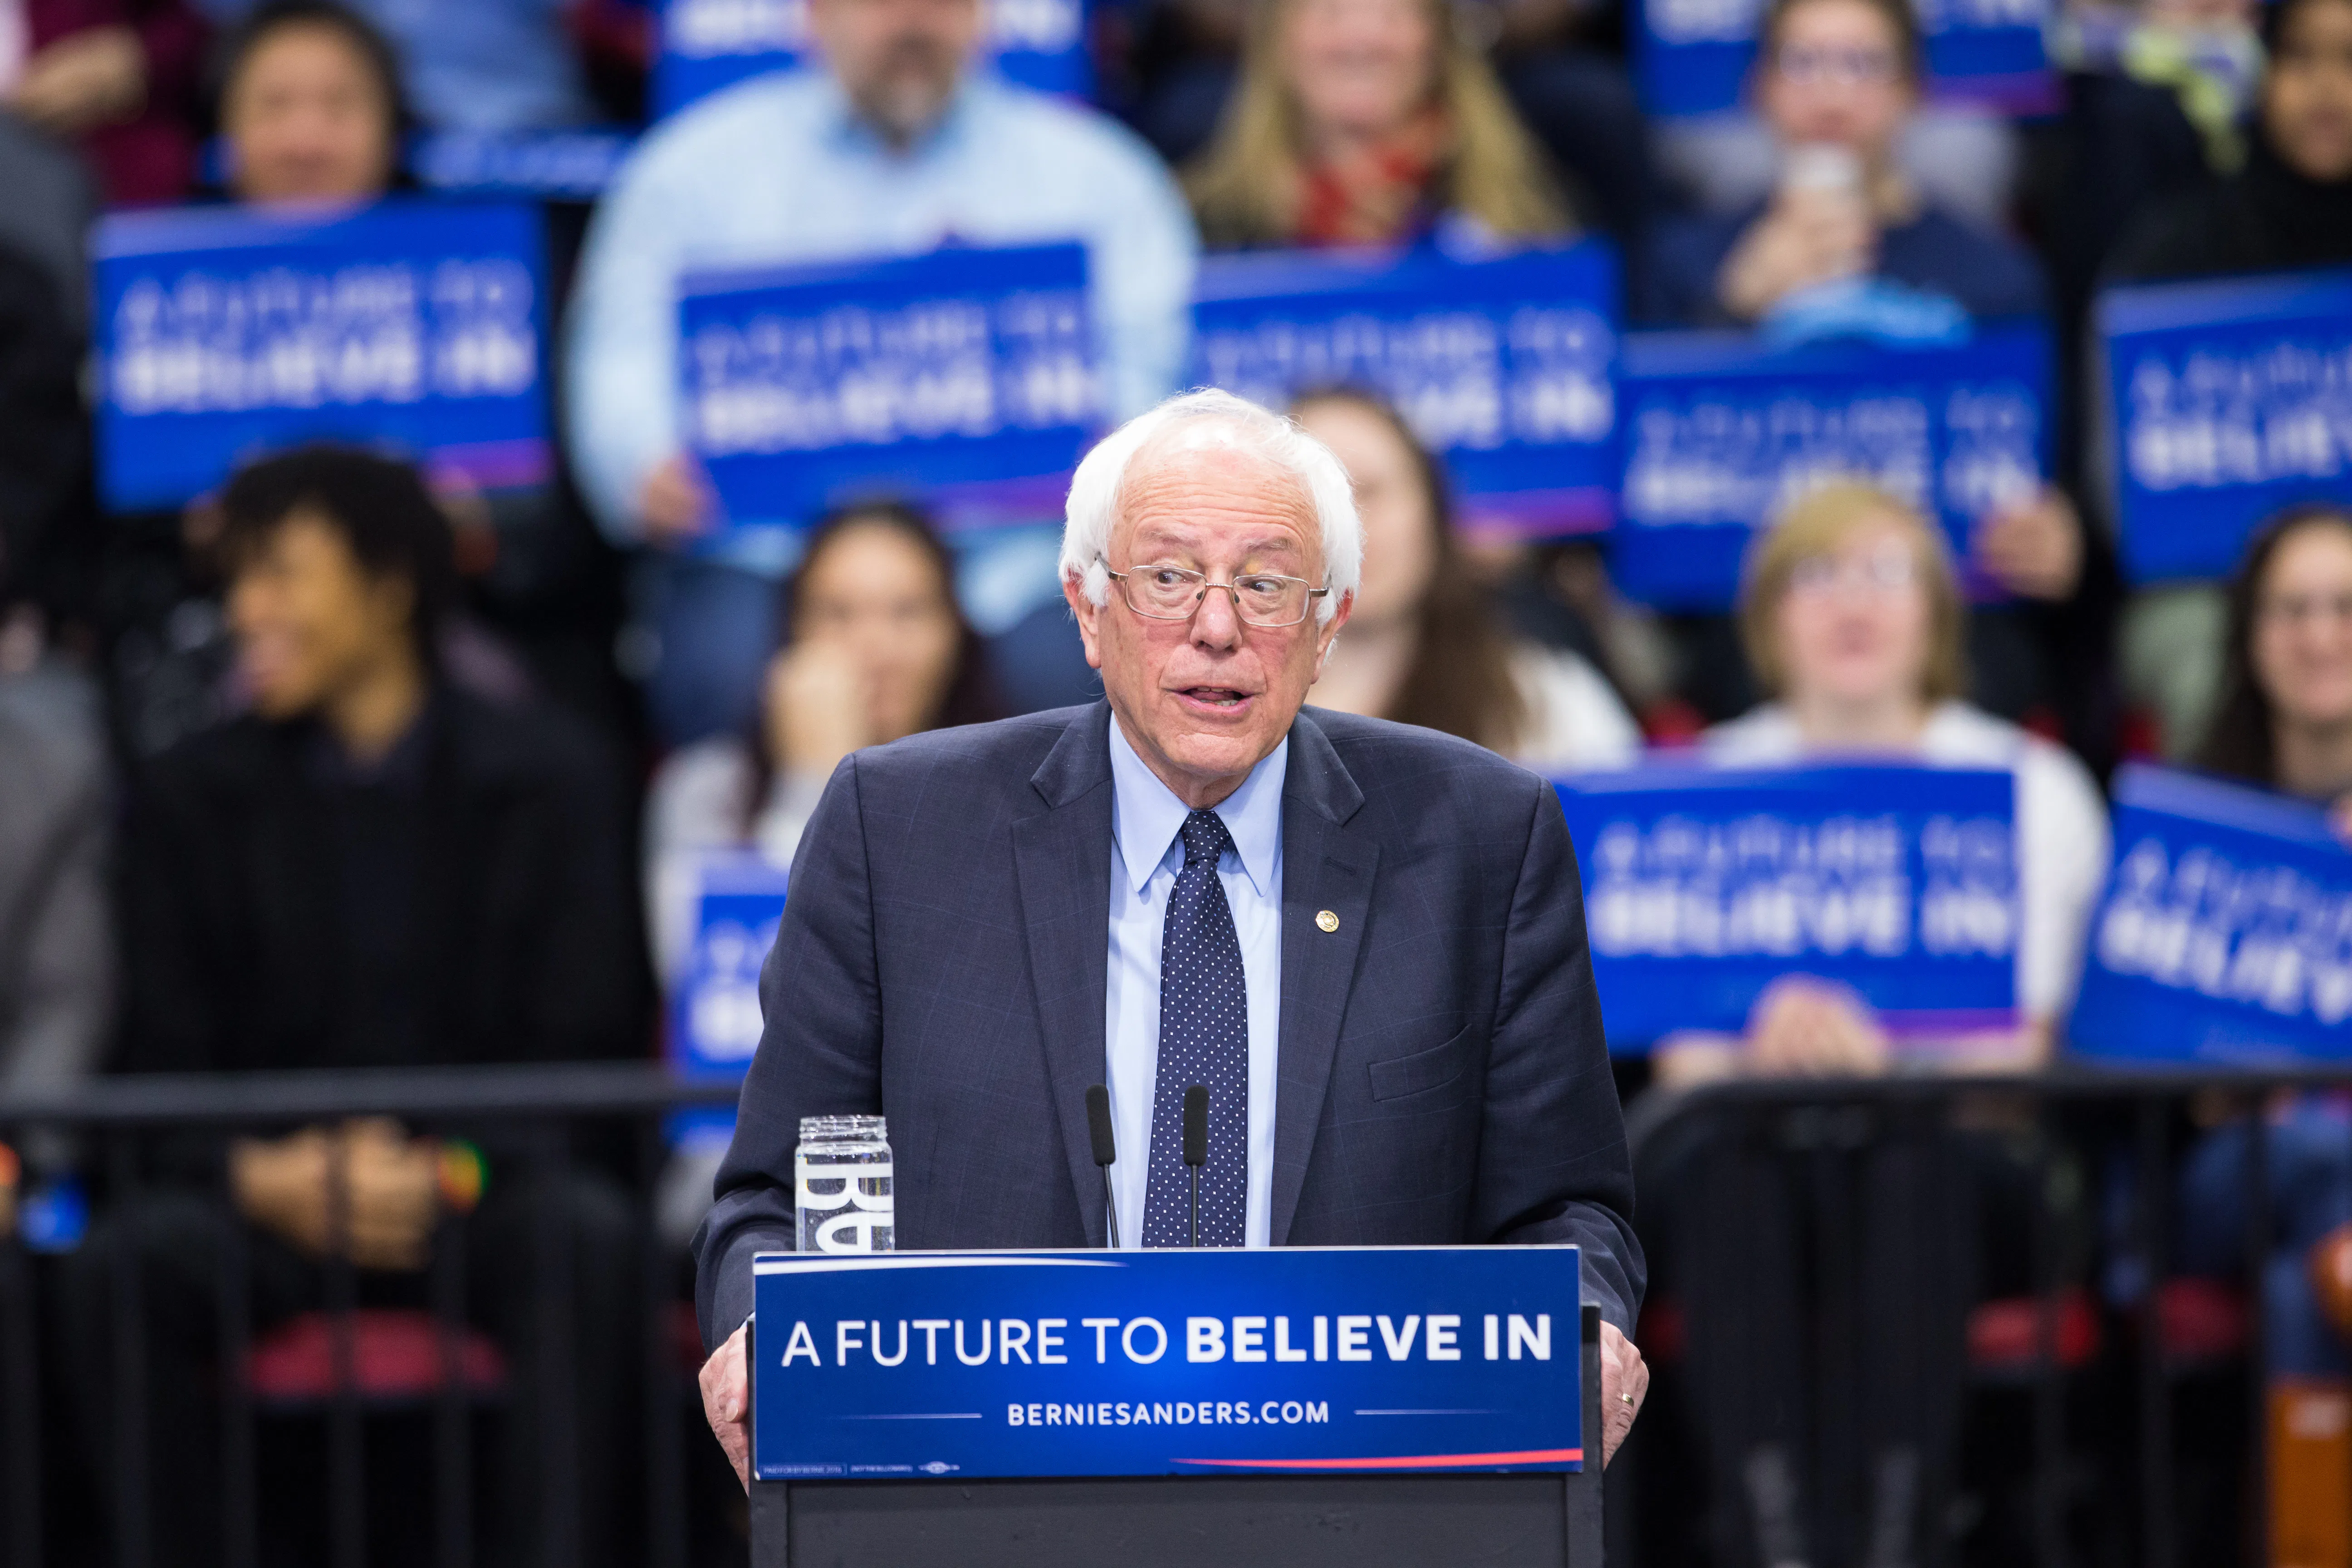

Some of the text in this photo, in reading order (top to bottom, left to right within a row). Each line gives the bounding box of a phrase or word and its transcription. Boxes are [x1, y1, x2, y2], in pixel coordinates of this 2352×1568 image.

[781, 1313, 1551, 1367] A FUTURE TO BELIEVE IN
[1008, 1401, 1329, 1426] BERNIESANDERS.COM
